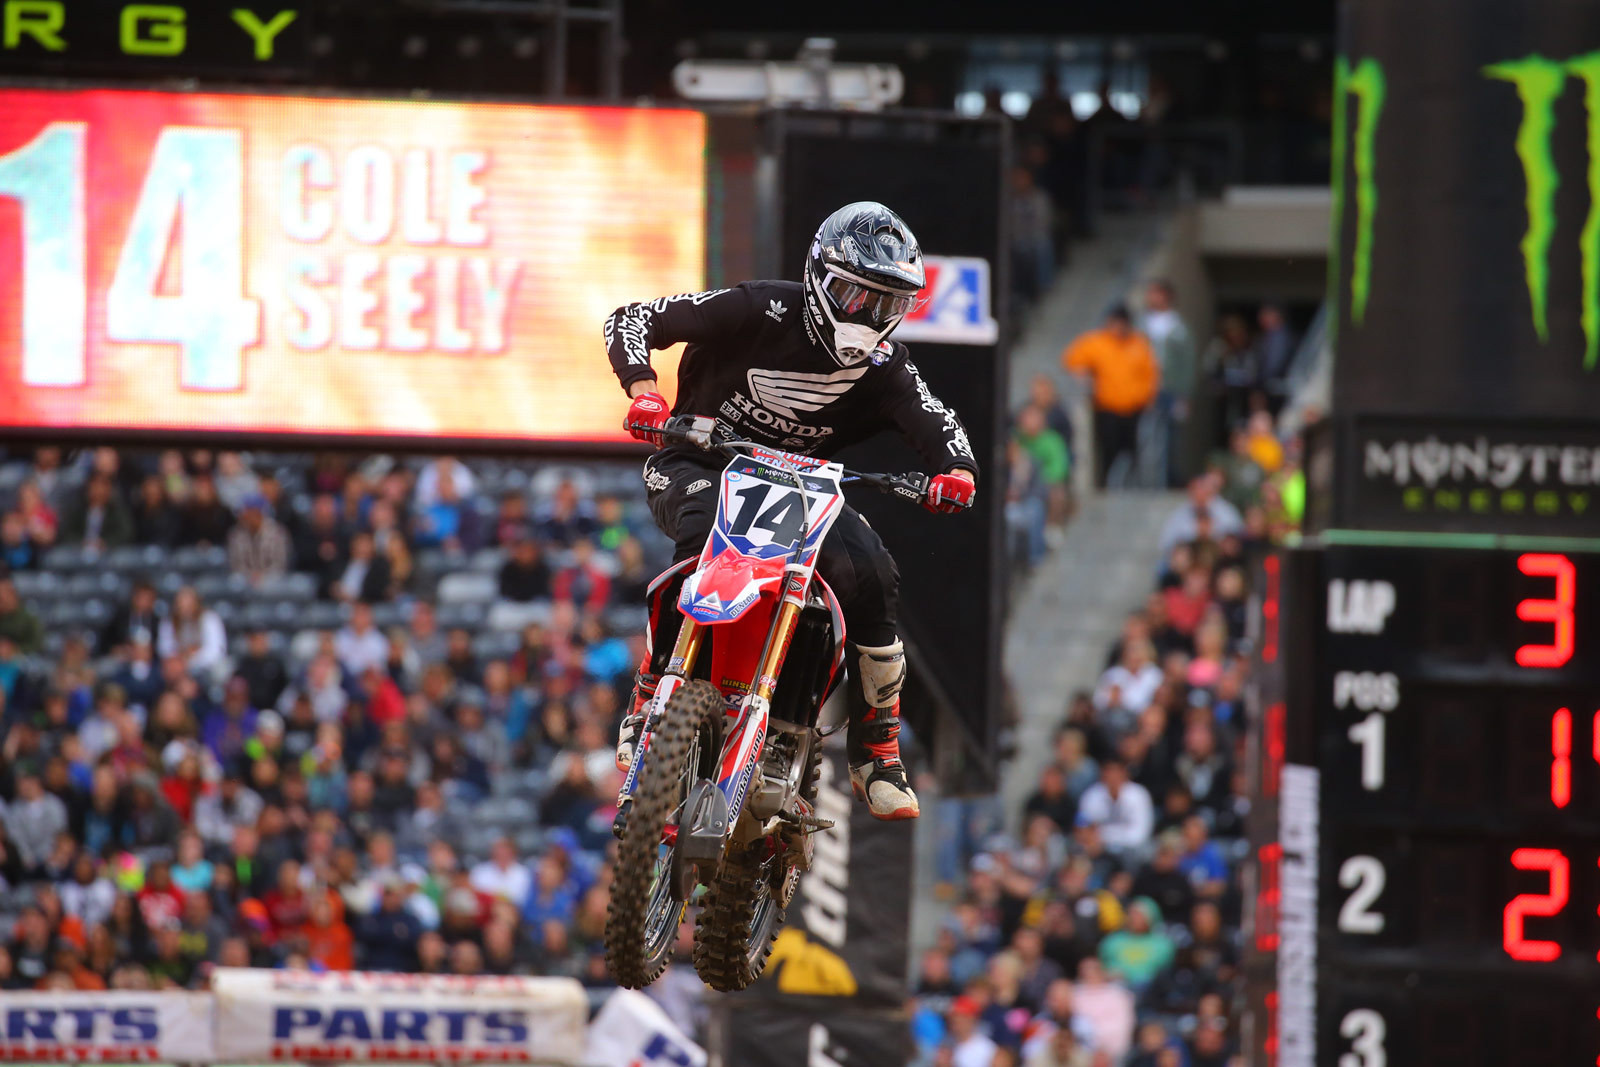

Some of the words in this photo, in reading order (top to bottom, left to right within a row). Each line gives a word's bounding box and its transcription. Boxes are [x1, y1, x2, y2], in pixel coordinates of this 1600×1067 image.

[280, 145, 492, 246] COLE
[0, 121, 261, 390] 14
[284, 256, 523, 354] SEELY
[765, 309, 782, 323] adidas
[808, 294, 824, 325] RED
[731, 391, 834, 438] HONDA
[764, 468, 803, 482] MONST
[894, 487, 919, 499] ARC
[728, 483, 817, 549] 14
[729, 592, 756, 618] DUNLOP
[1326, 578, 1396, 634] LAP
[1515, 553, 1576, 668] 3
[721, 678, 752, 691] HINSO
[728, 774, 749, 822] Honda
[744, 728, 765, 777] Racing
[1348, 713, 1386, 790] 1
[1338, 855, 1387, 934] 2
[7, 1007, 160, 1041] RTS
[274, 1007, 530, 1043] PARTS
[1338, 1008, 1388, 1067] 3
